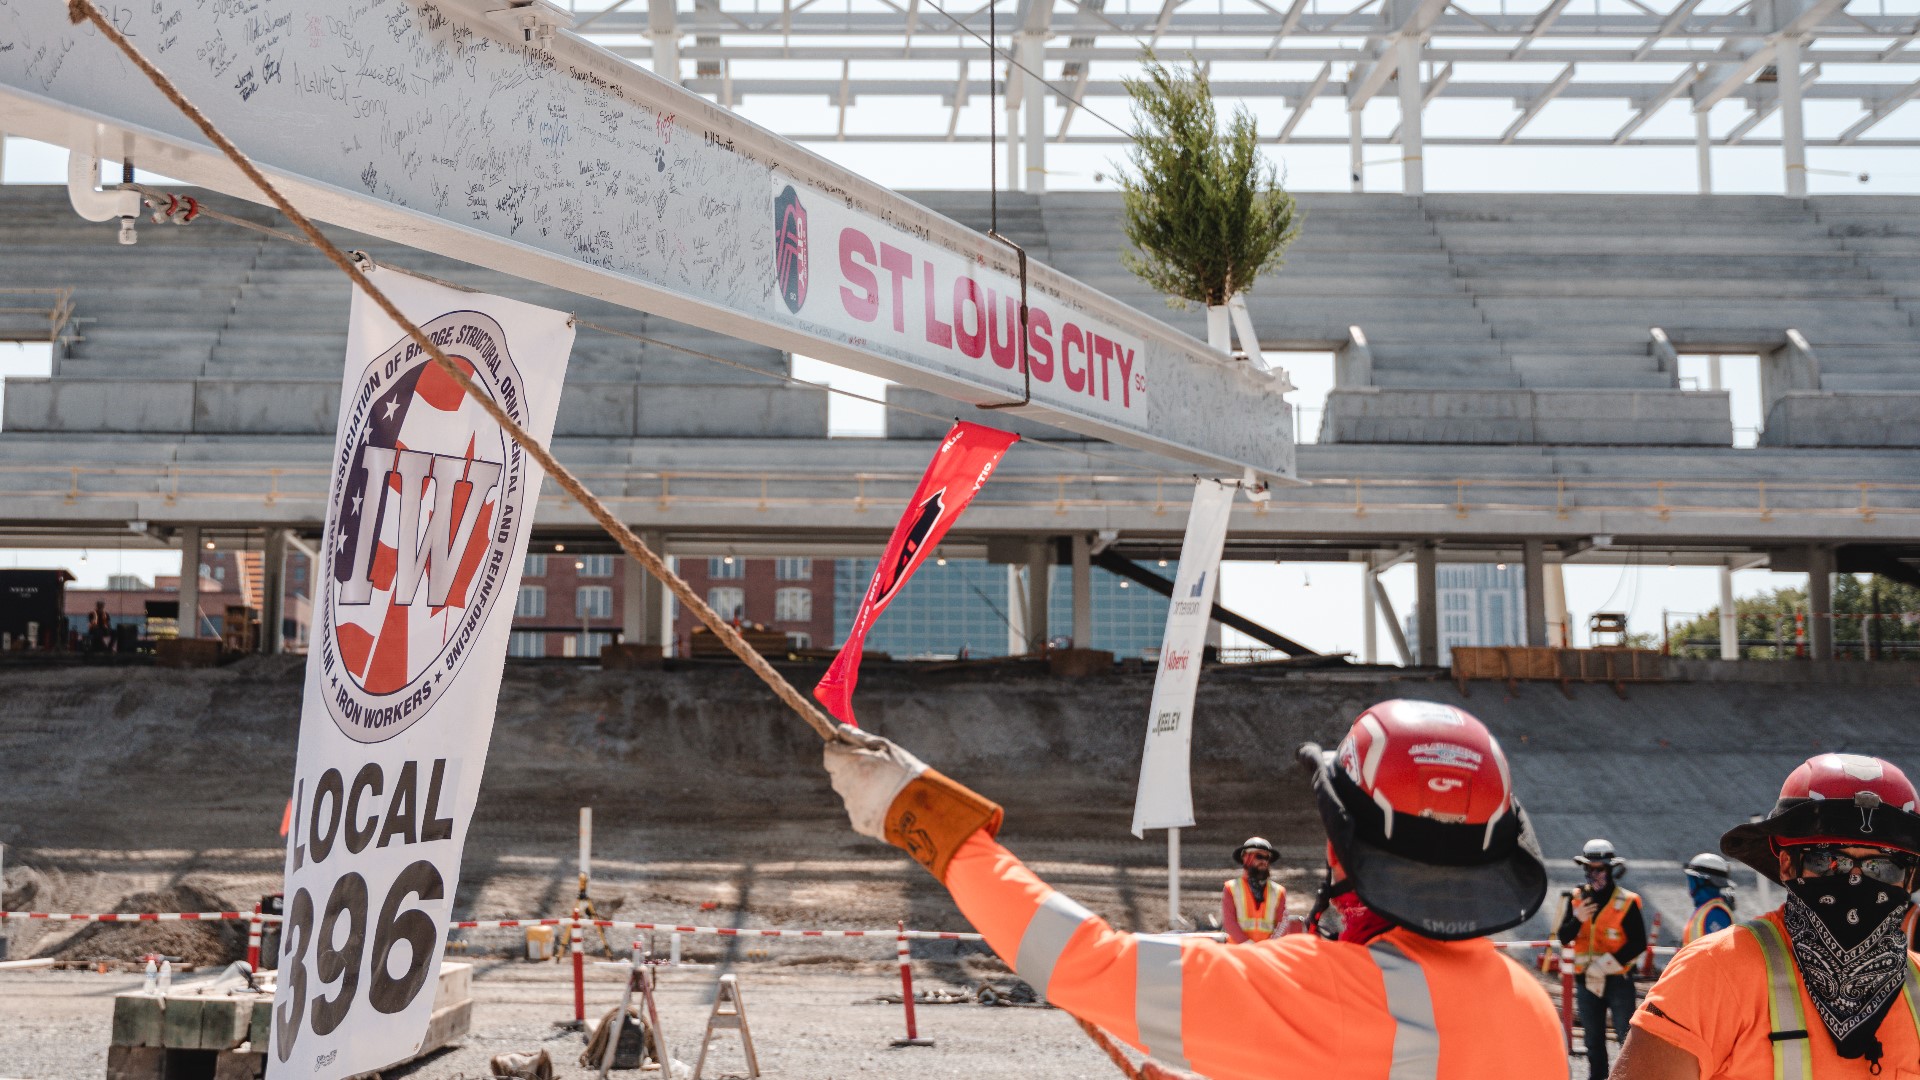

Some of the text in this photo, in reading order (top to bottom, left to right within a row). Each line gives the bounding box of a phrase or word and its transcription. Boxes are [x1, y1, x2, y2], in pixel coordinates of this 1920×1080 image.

[797, 217, 805, 289] CITY
[405, 325, 455, 363] BRDGE,
[456, 324, 502, 386] STRUCTURAL,
[838, 227, 913, 333] ST
[923, 261, 1054, 383] LOUIS
[1061, 322, 1135, 408] CITY
[1135, 372, 1147, 393] SC
[384, 351, 402, 381] OF
[334, 371, 382, 507] ASSOCIATION
[501, 375, 523, 500] ORNAENTAL
[339, 445, 503, 607] IW
[497, 504, 514, 544] AND
[445, 549, 504, 671] REINFORCING
[335, 680, 432, 729] IRON WORKERS
[292, 758, 454, 876] LOCAL
[276, 859, 445, 1064] 396
[1423, 918, 1477, 935] SMOKE
